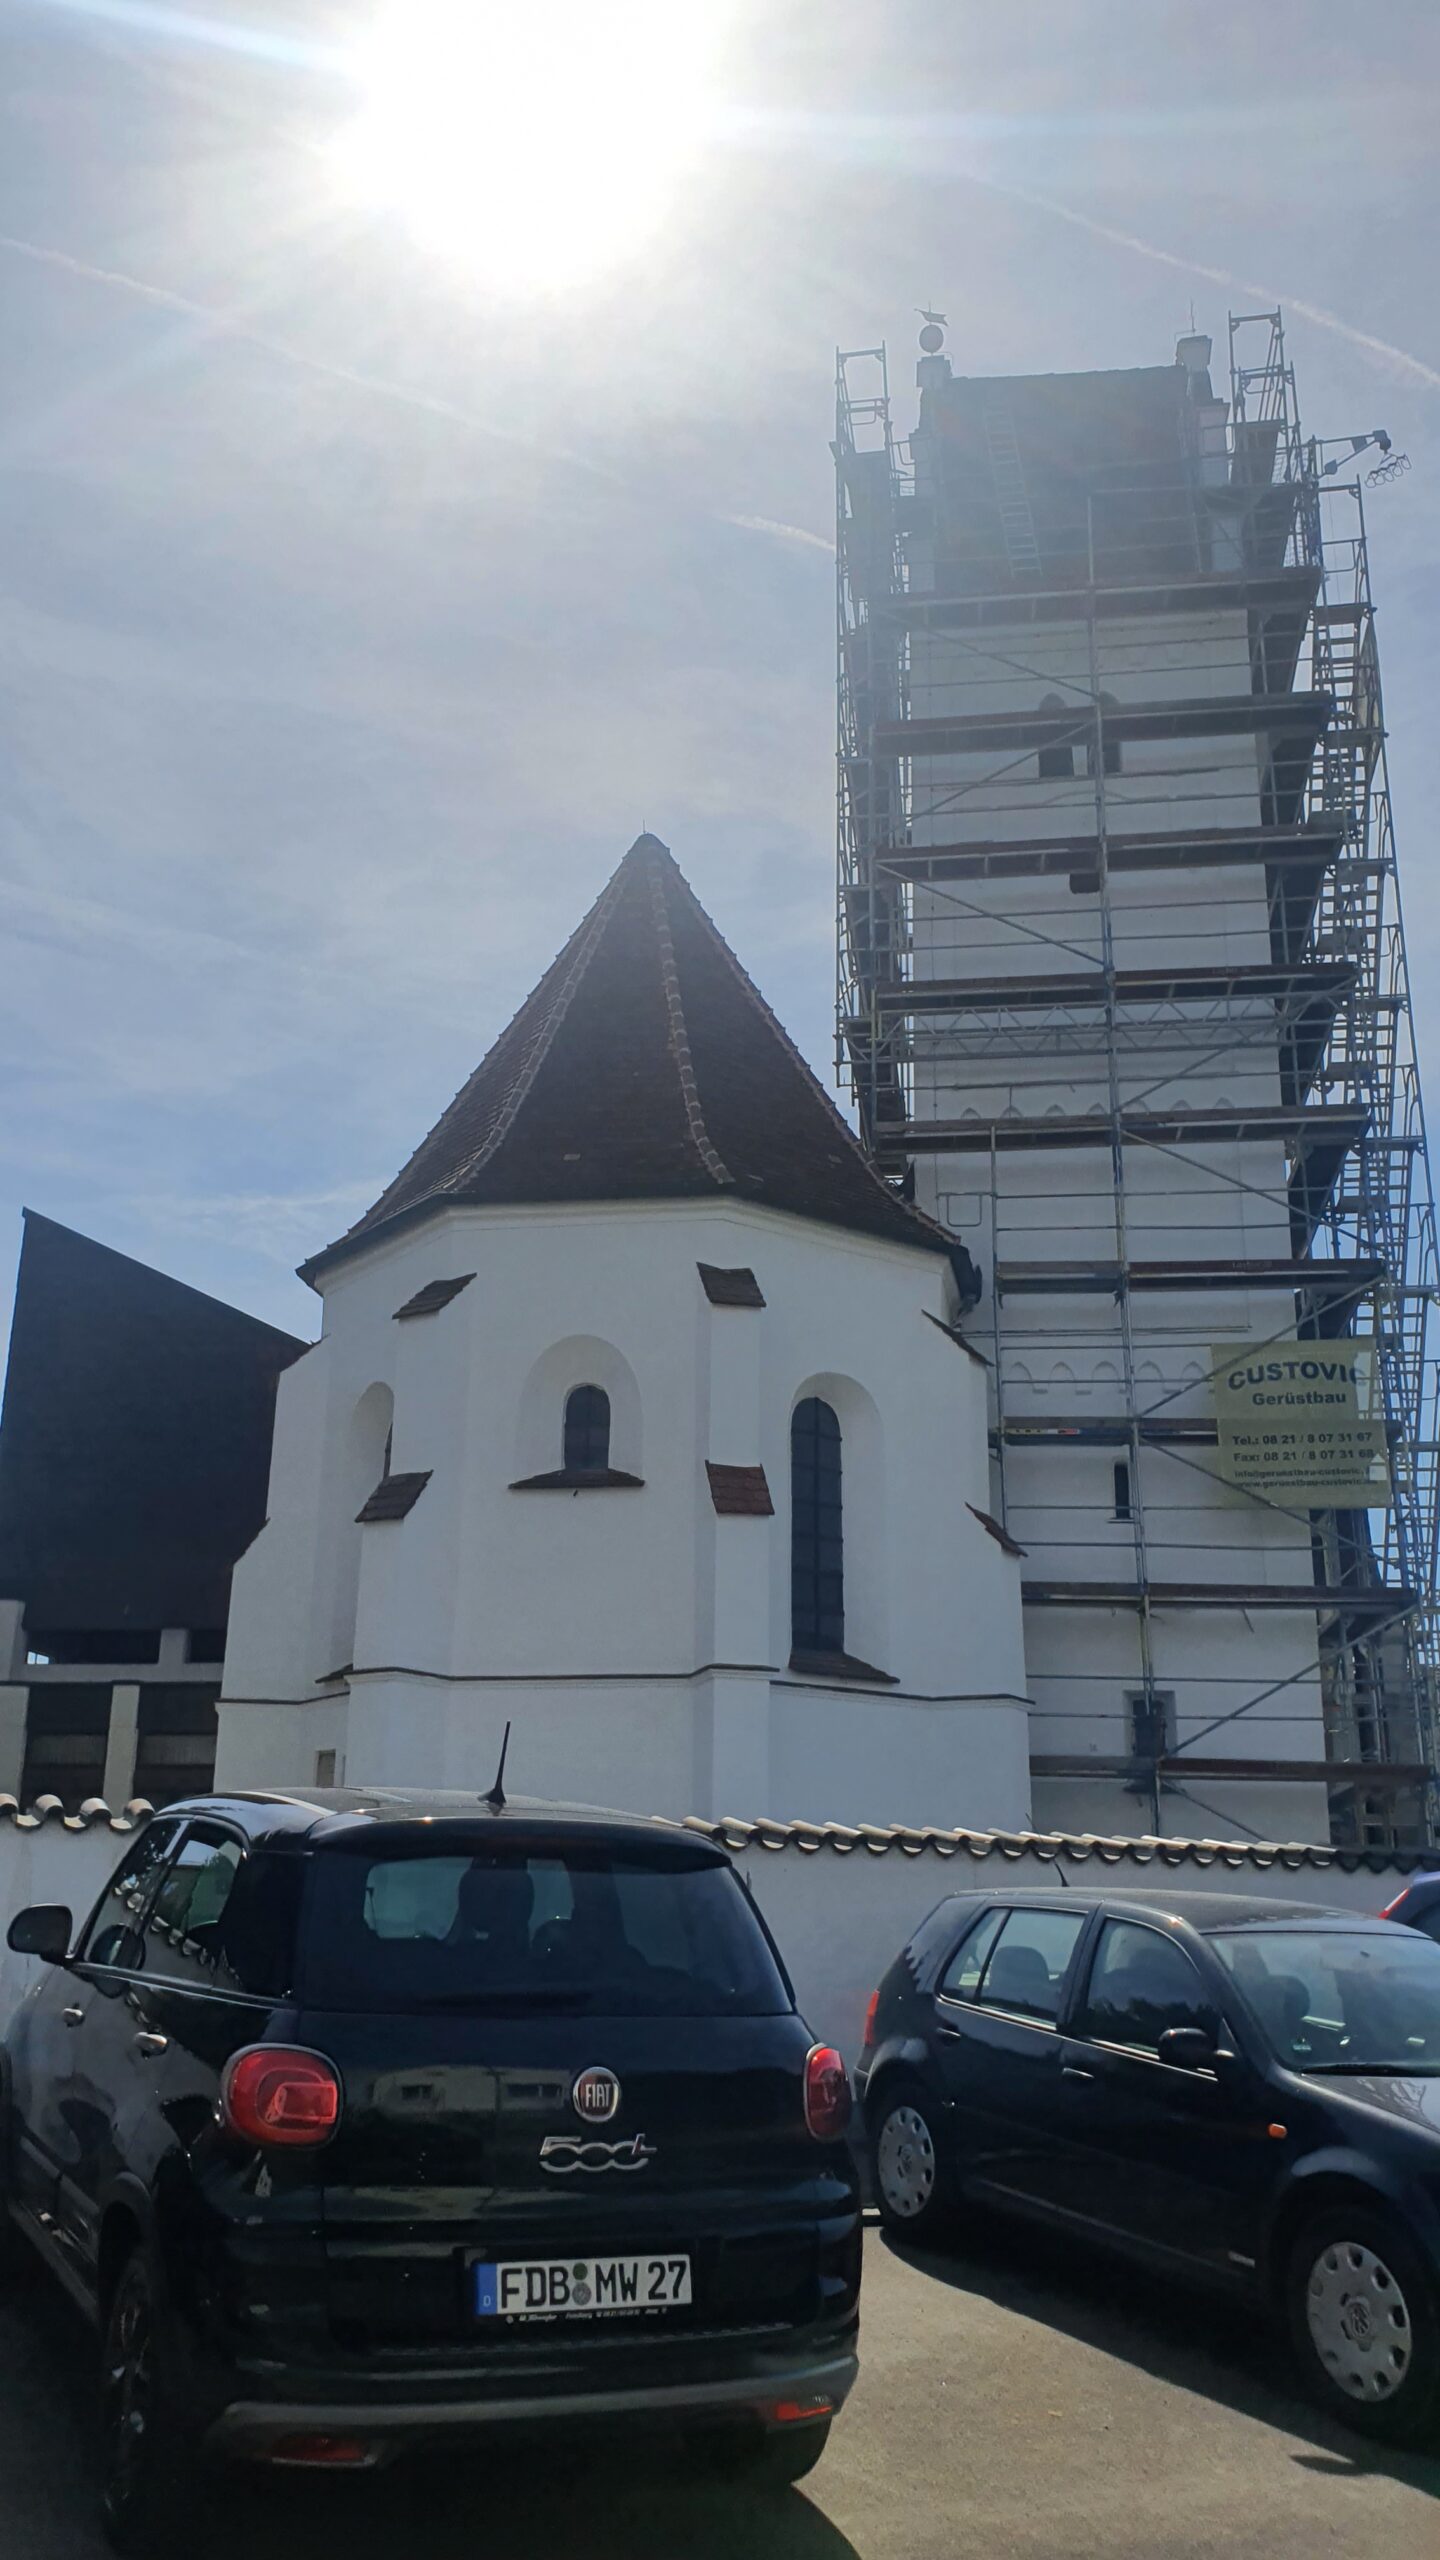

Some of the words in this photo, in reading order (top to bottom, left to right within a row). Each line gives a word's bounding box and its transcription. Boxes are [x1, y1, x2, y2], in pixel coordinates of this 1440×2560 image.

[1252, 1391, 1346, 1406] Gerüstbau
[1232, 1435, 1259, 1446] Tel.:
[1262, 1434, 1278, 1445] 08
[1281, 1434, 1296, 1445] 21
[1307, 1434, 1315, 1444] 8
[1318, 1433, 1334, 1443] 07
[1338, 1432, 1352, 1443] 31
[1356, 1431, 1373, 1442] 67
[1233, 1452, 1260, 1463] Fax:
[1263, 1452, 1279, 1462] 08
[1282, 1451, 1297, 1462] 21
[1308, 1450, 1316, 1460] 8
[1320, 1450, 1335, 1460] 07
[1340, 1449, 1354, 1459] 31
[585, 2082, 612, 2108] FIAT
[501, 2266, 570, 2309] FDB
[595, 2262, 639, 2303] MW
[647, 2260, 688, 2301] 27
[483, 2296, 491, 2307] D
